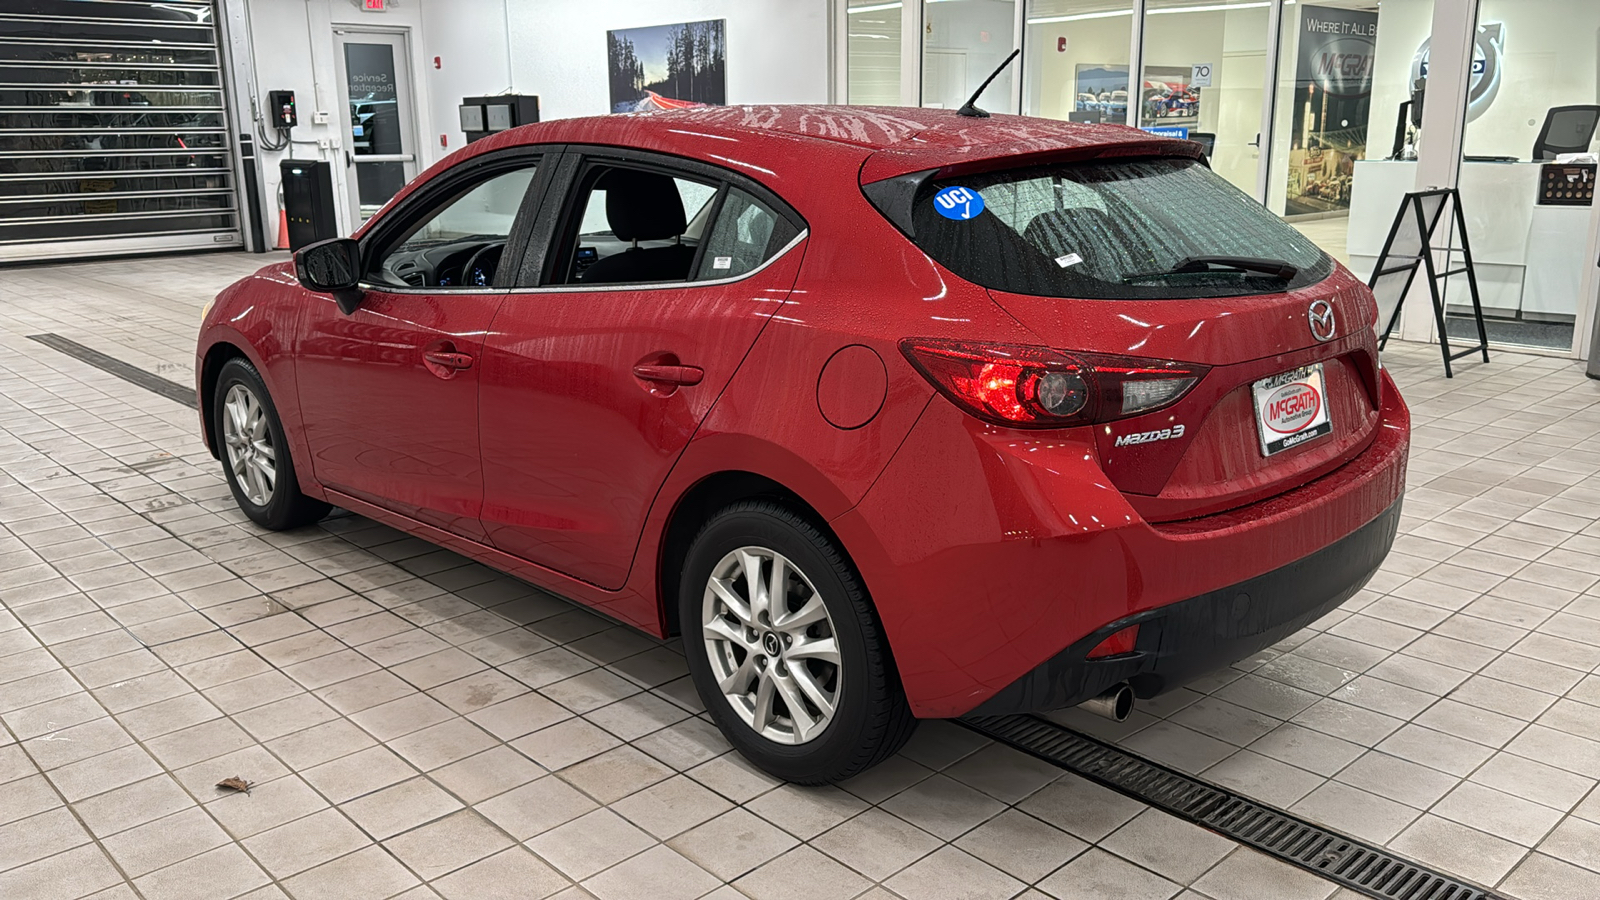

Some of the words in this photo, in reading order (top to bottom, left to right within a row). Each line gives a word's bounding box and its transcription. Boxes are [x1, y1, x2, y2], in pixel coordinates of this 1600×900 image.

[1307, 18, 1340, 34] WHERE
[1341, 21, 1350, 34] IT
[1350, 22, 1367, 36] ALL
[1368, 24, 1378, 37] B
[1195, 66, 1210, 77] 70
[936, 187, 973, 209] UCI
[1270, 391, 1315, 421] McGRATH
[1283, 430, 1317, 447] GoMcGrath.com
